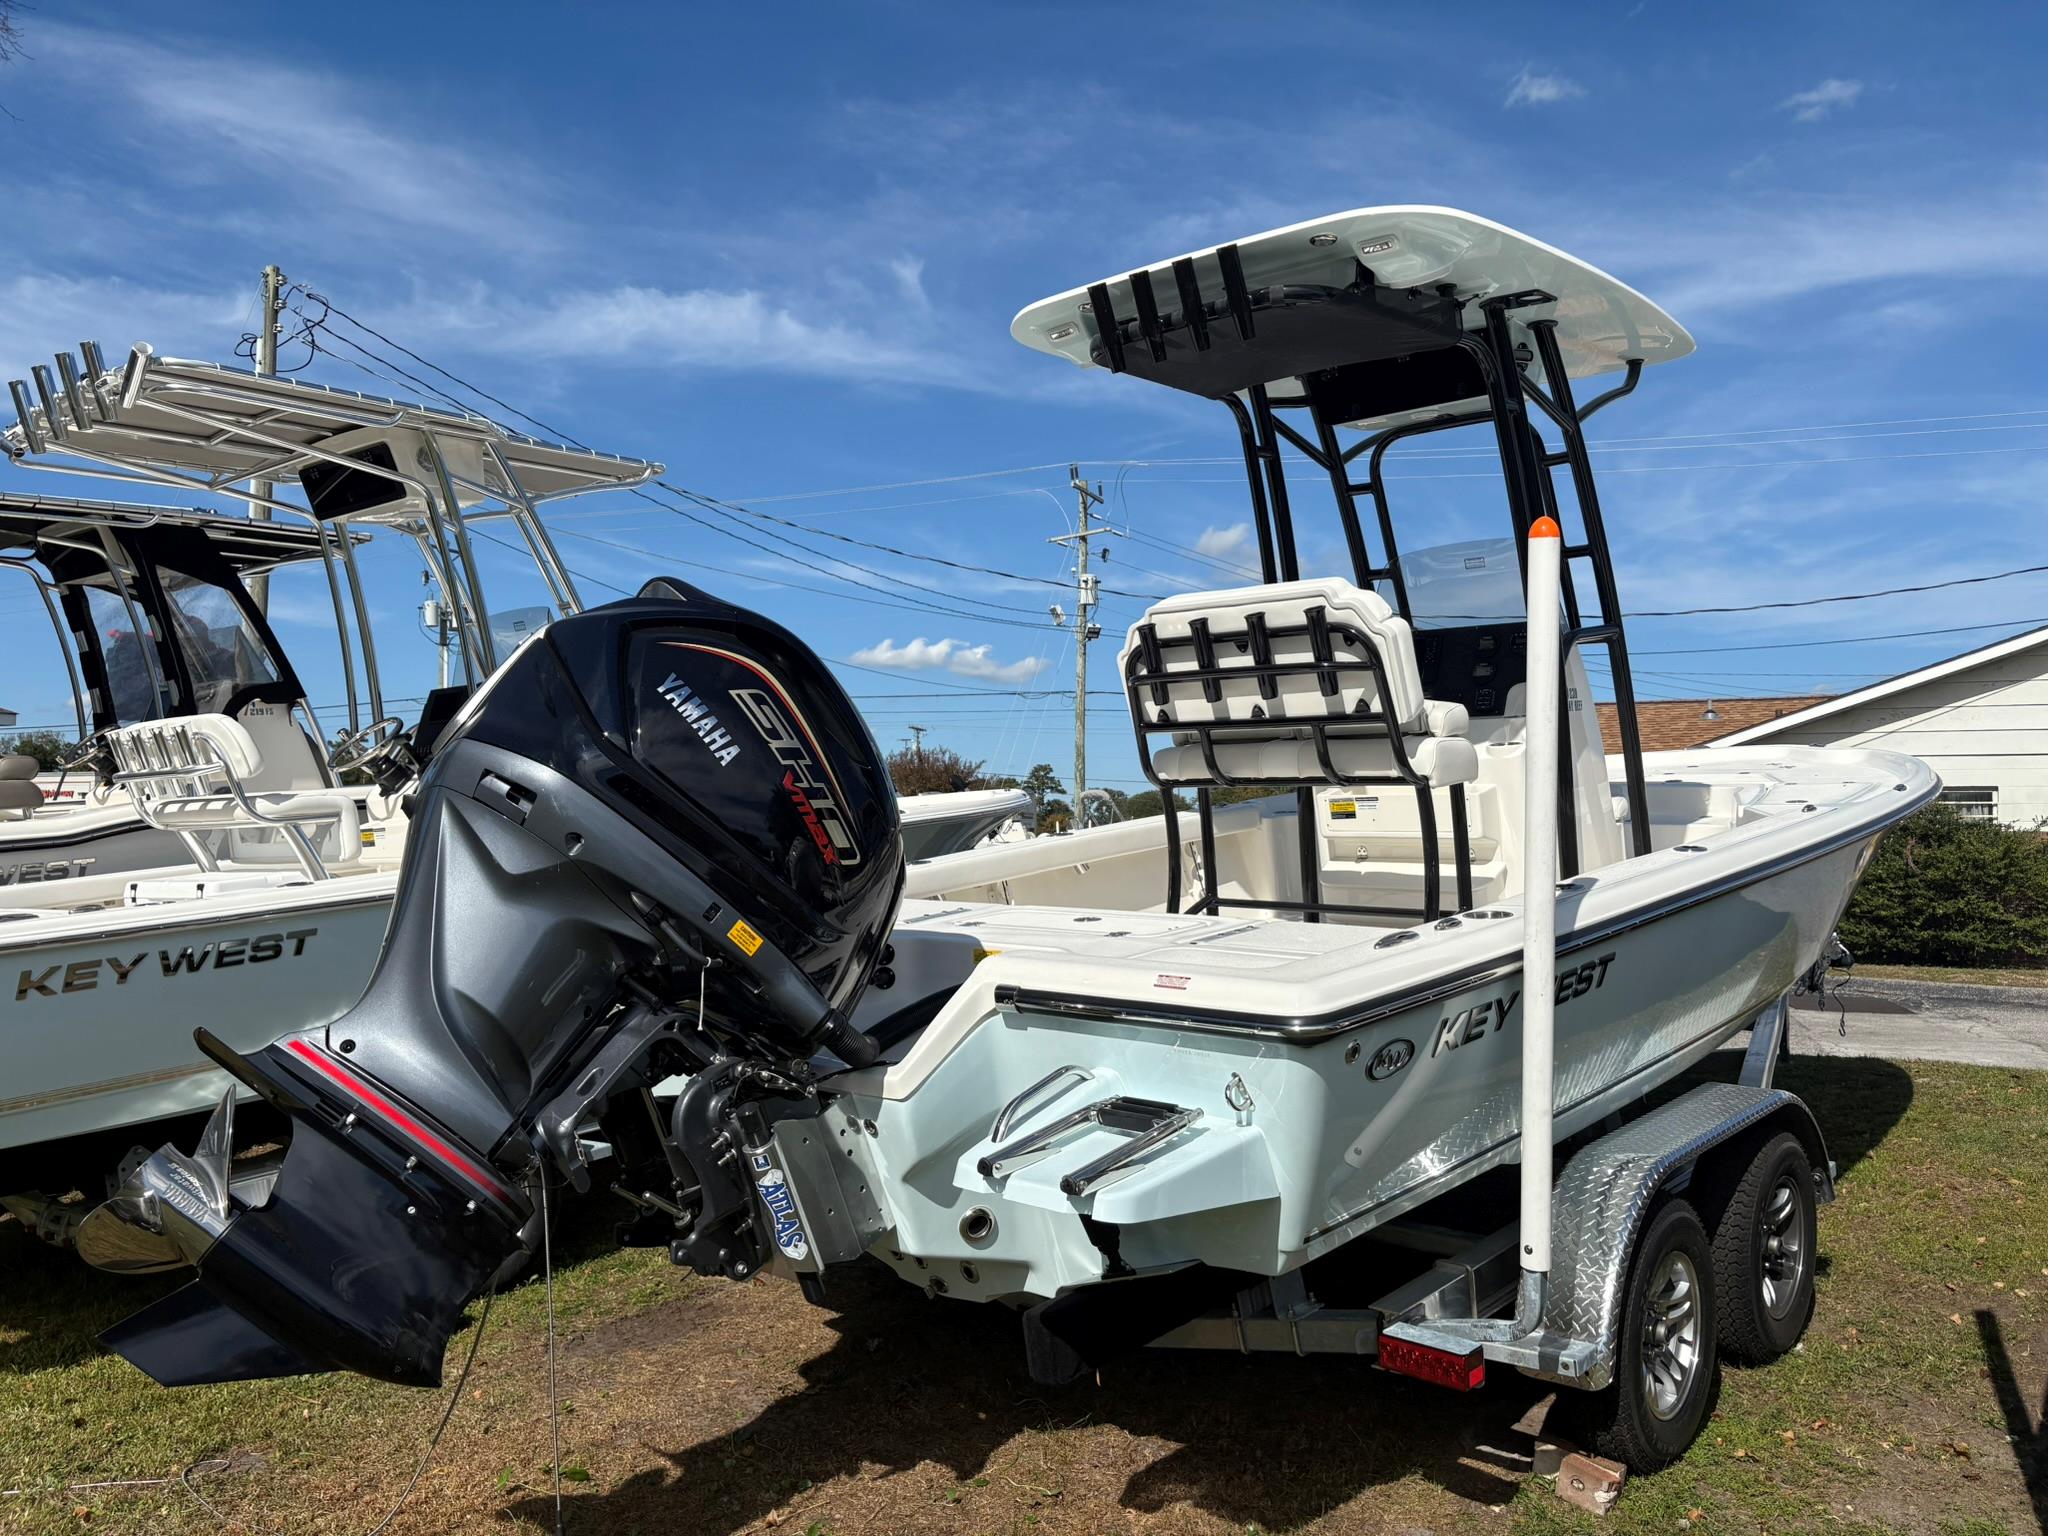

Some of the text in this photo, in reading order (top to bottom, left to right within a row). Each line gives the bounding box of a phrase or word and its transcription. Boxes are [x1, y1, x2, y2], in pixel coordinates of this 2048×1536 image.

[656, 672, 741, 767] YAMAHA
[728, 689, 861, 866] SHO
[15, 928, 318, 1001] KEY WEST
[1431, 952, 1617, 1058] KEY EST
[162, 1183, 209, 1223] YAMAHA
[757, 1180, 805, 1248] ATLAS
